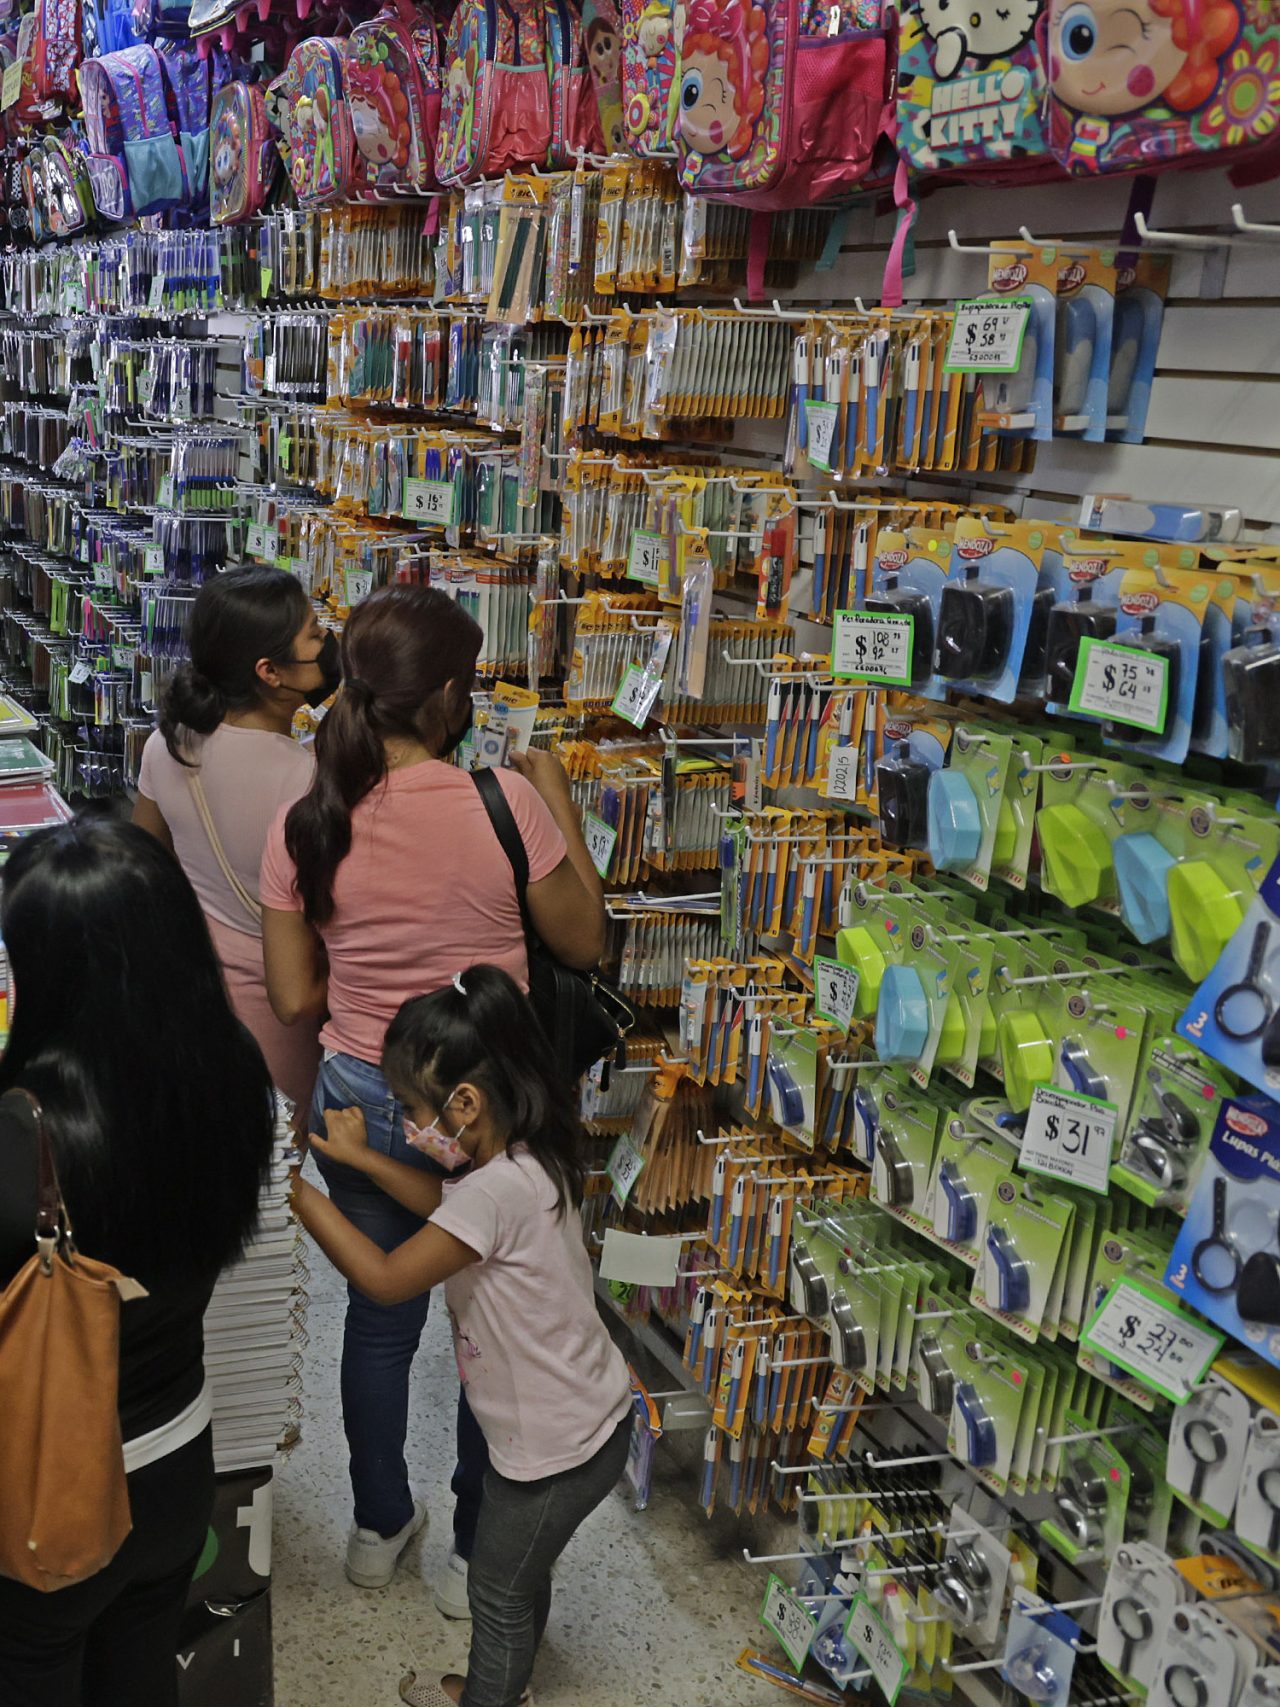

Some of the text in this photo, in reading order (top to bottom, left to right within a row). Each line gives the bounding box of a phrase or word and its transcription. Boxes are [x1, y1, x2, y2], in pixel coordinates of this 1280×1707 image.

[930, 69, 1024, 117] HELLO
[929, 104, 1020, 149] KITTY
[415, 495, 424, 509] $
[958, 537, 994, 555] MENDOZA
[879, 551, 908, 567] MENDOZA
[1121, 591, 1160, 609] MENDOZA
[872, 630, 890, 647] 108
[872, 646, 885, 660] 92
[1102, 664, 1117, 693] $
[1122, 663, 1138, 680] 75
[1118, 681, 1137, 700] 64
[833, 756, 851, 795] 1220215
[829, 981, 838, 1001] $
[1045, 1114, 1060, 1141] $
[1062, 1118, 1090, 1156] 31
[1222, 1130, 1260, 1160] Lupas
[1118, 1315, 1141, 1348] $
